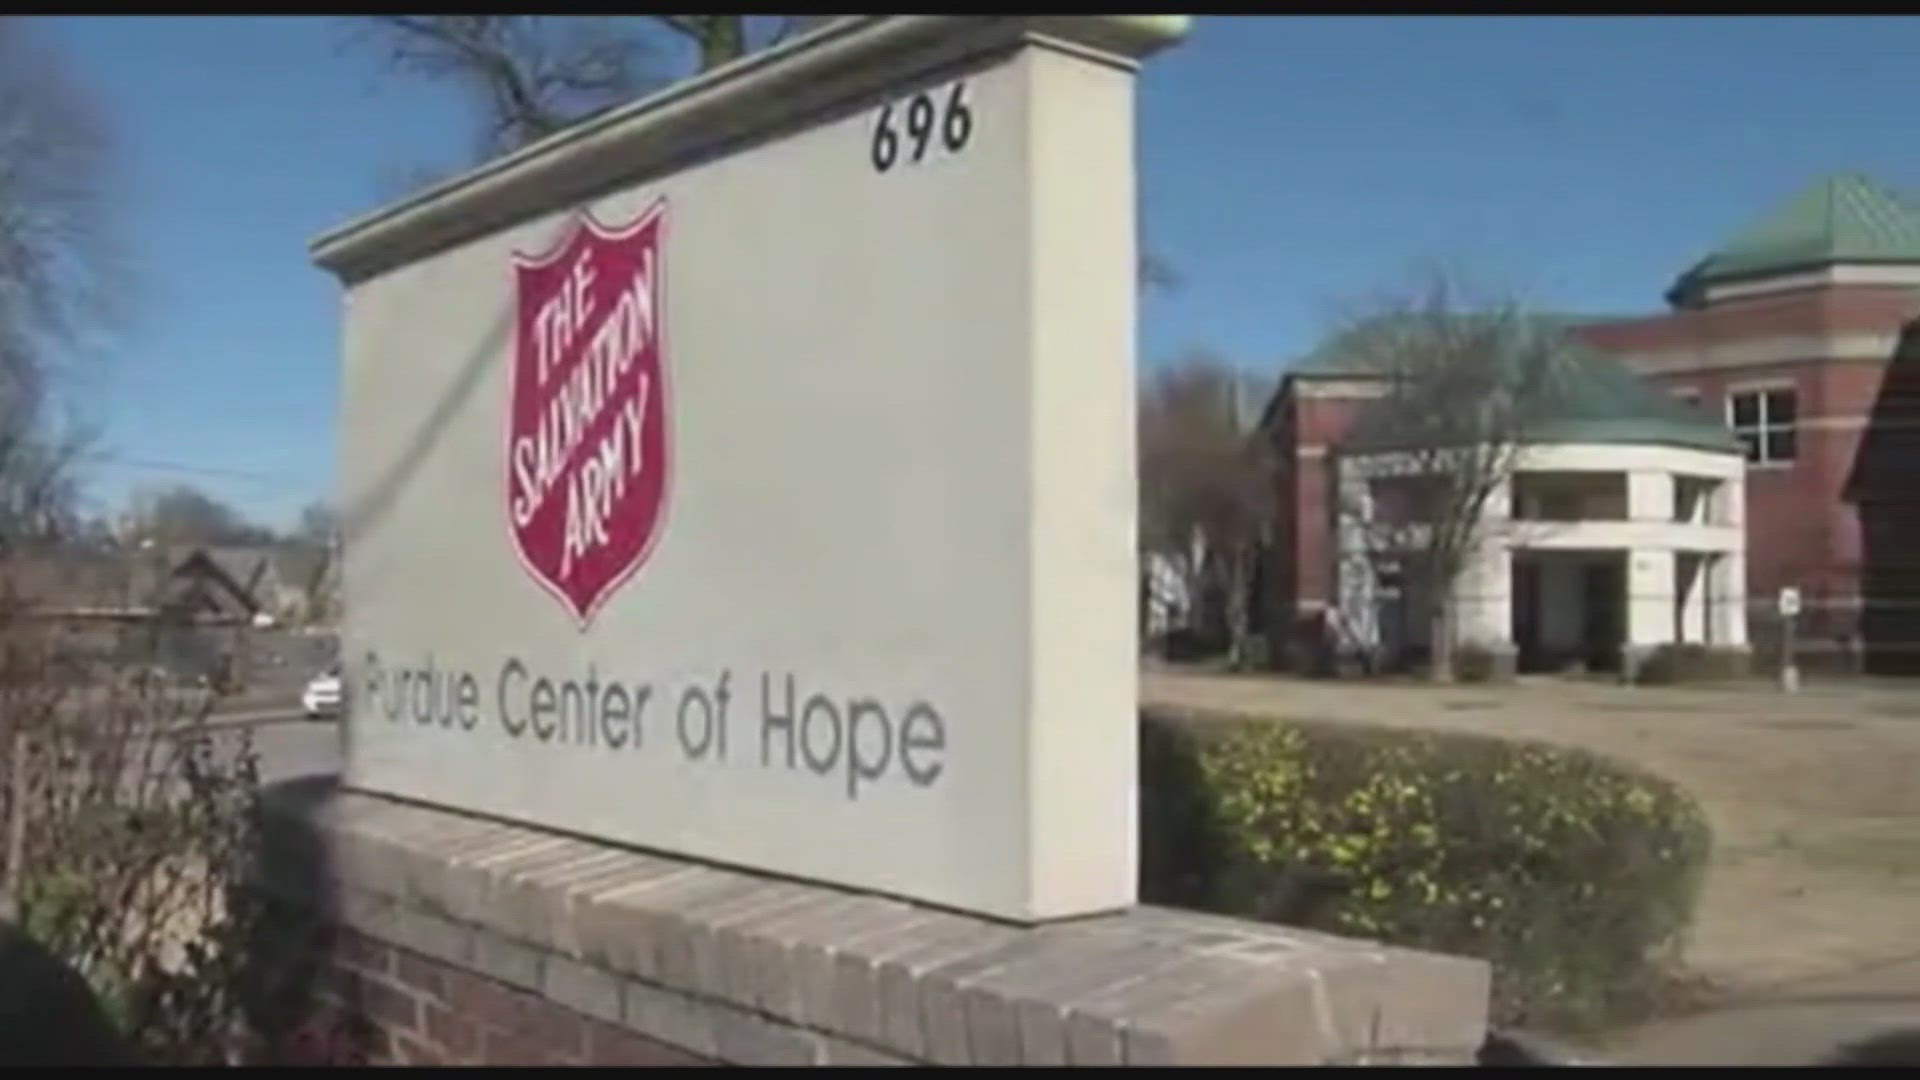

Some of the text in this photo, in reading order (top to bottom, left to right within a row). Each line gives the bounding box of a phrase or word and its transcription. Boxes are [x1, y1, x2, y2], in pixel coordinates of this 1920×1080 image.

[871, 83, 972, 173] 696
[513, 247, 655, 528] SALVATION
[532, 248, 597, 386] THE
[559, 373, 649, 581] ARMY
[364, 649, 947, 799] Purdue Center of Hope
